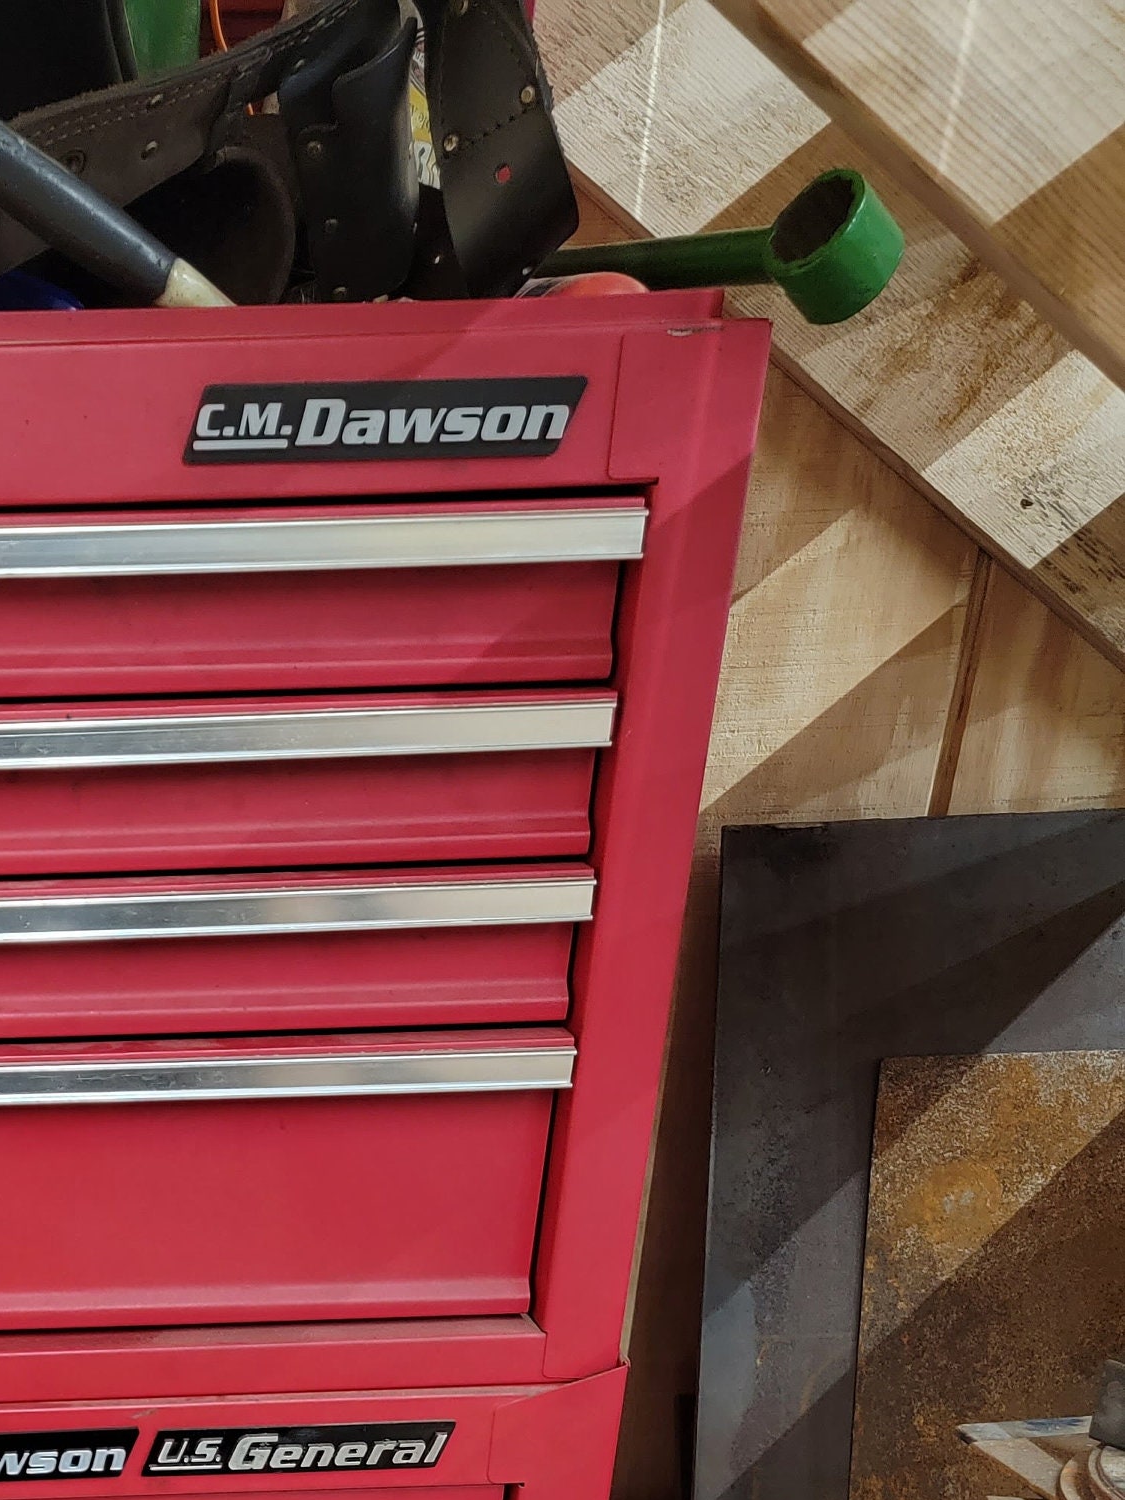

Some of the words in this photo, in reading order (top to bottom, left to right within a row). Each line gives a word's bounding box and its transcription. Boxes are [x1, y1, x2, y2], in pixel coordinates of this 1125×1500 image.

[194, 402, 293, 440] C.M.
[295, 398, 570, 446] Dawson
[157, 1437, 223, 1465] U.S.
[227, 1432, 449, 1471] General
